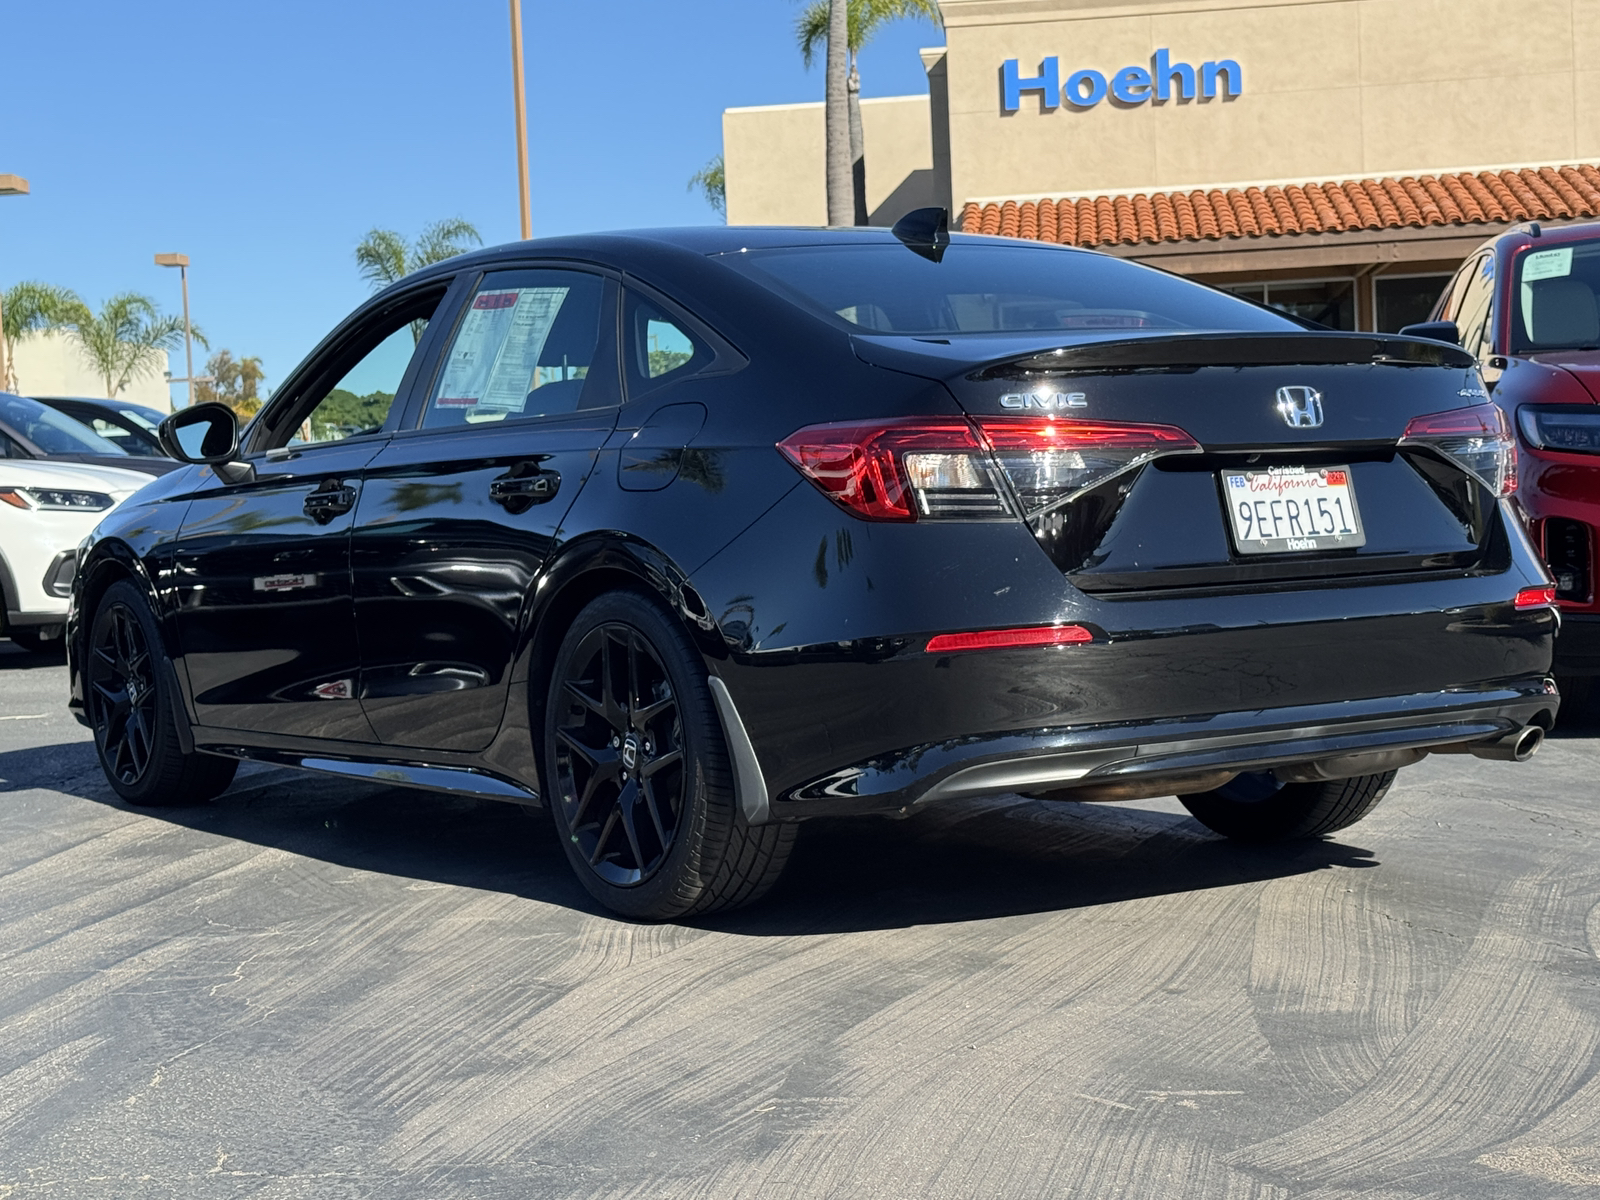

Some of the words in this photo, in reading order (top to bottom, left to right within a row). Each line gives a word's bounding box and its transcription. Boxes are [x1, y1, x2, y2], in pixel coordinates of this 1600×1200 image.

[999, 48, 1243, 116] Hoehn
[999, 391, 1088, 410] CIVIC
[1229, 477, 1246, 488] FEB
[1250, 475, 1328, 496] California
[1239, 497, 1352, 539] 9EFR151
[1286, 538, 1318, 551] Hoehn
